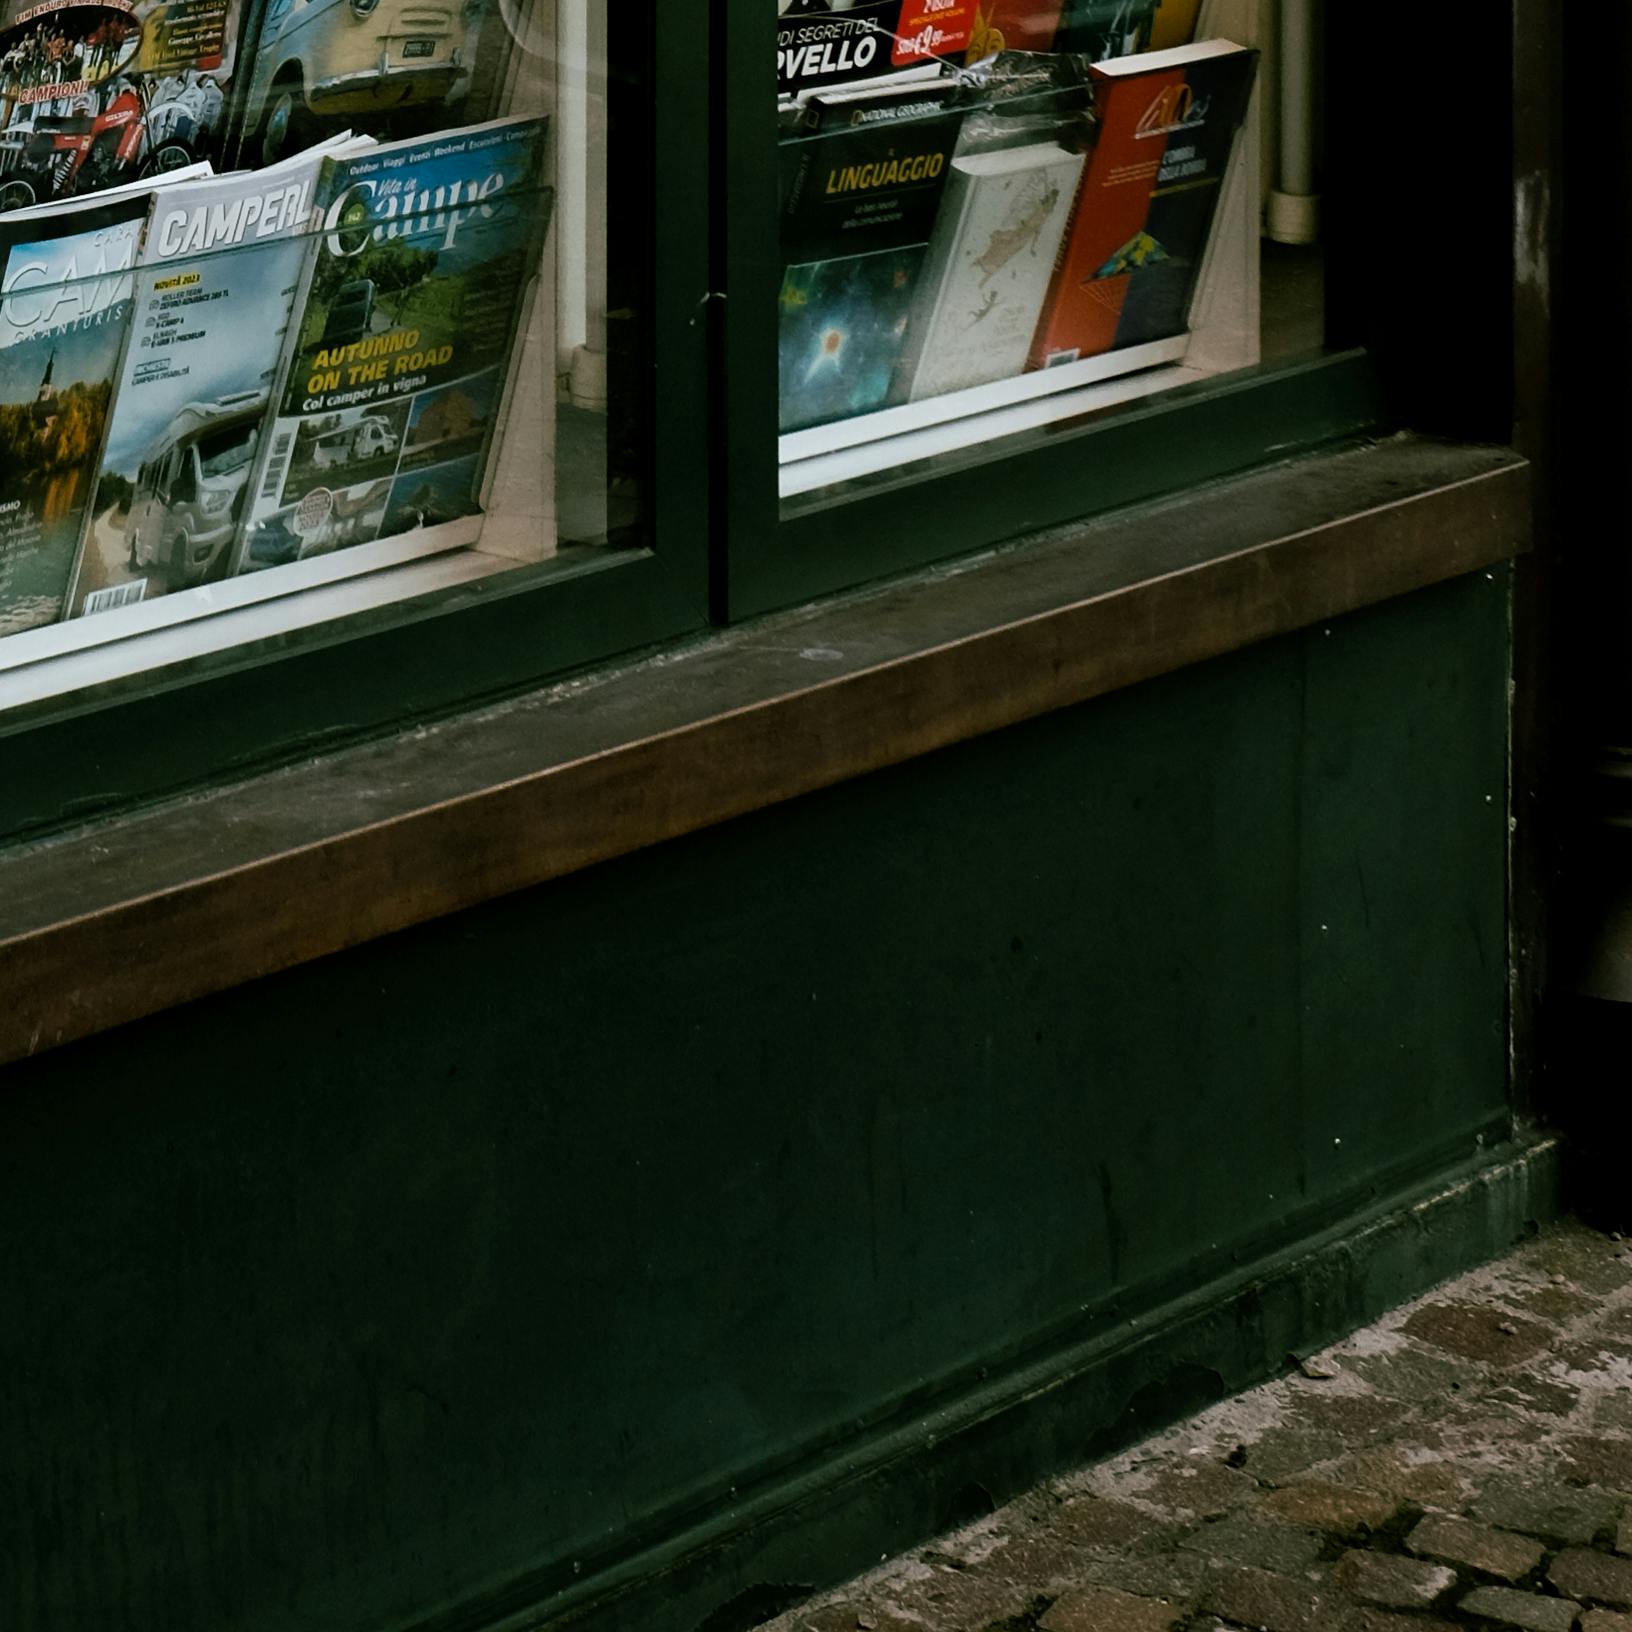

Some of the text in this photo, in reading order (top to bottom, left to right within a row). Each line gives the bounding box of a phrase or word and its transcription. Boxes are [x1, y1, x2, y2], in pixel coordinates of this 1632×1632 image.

[798, 22, 856, 45] SEGRETI
[17, 78, 91, 106] CAMPIONI!
[824, 151, 946, 196] LINGUAGGIO
[313, 328, 422, 370] AUTUNNO
[306, 344, 454, 397] ON THE ROAD
[302, 374, 428, 412] Col camper vigna
